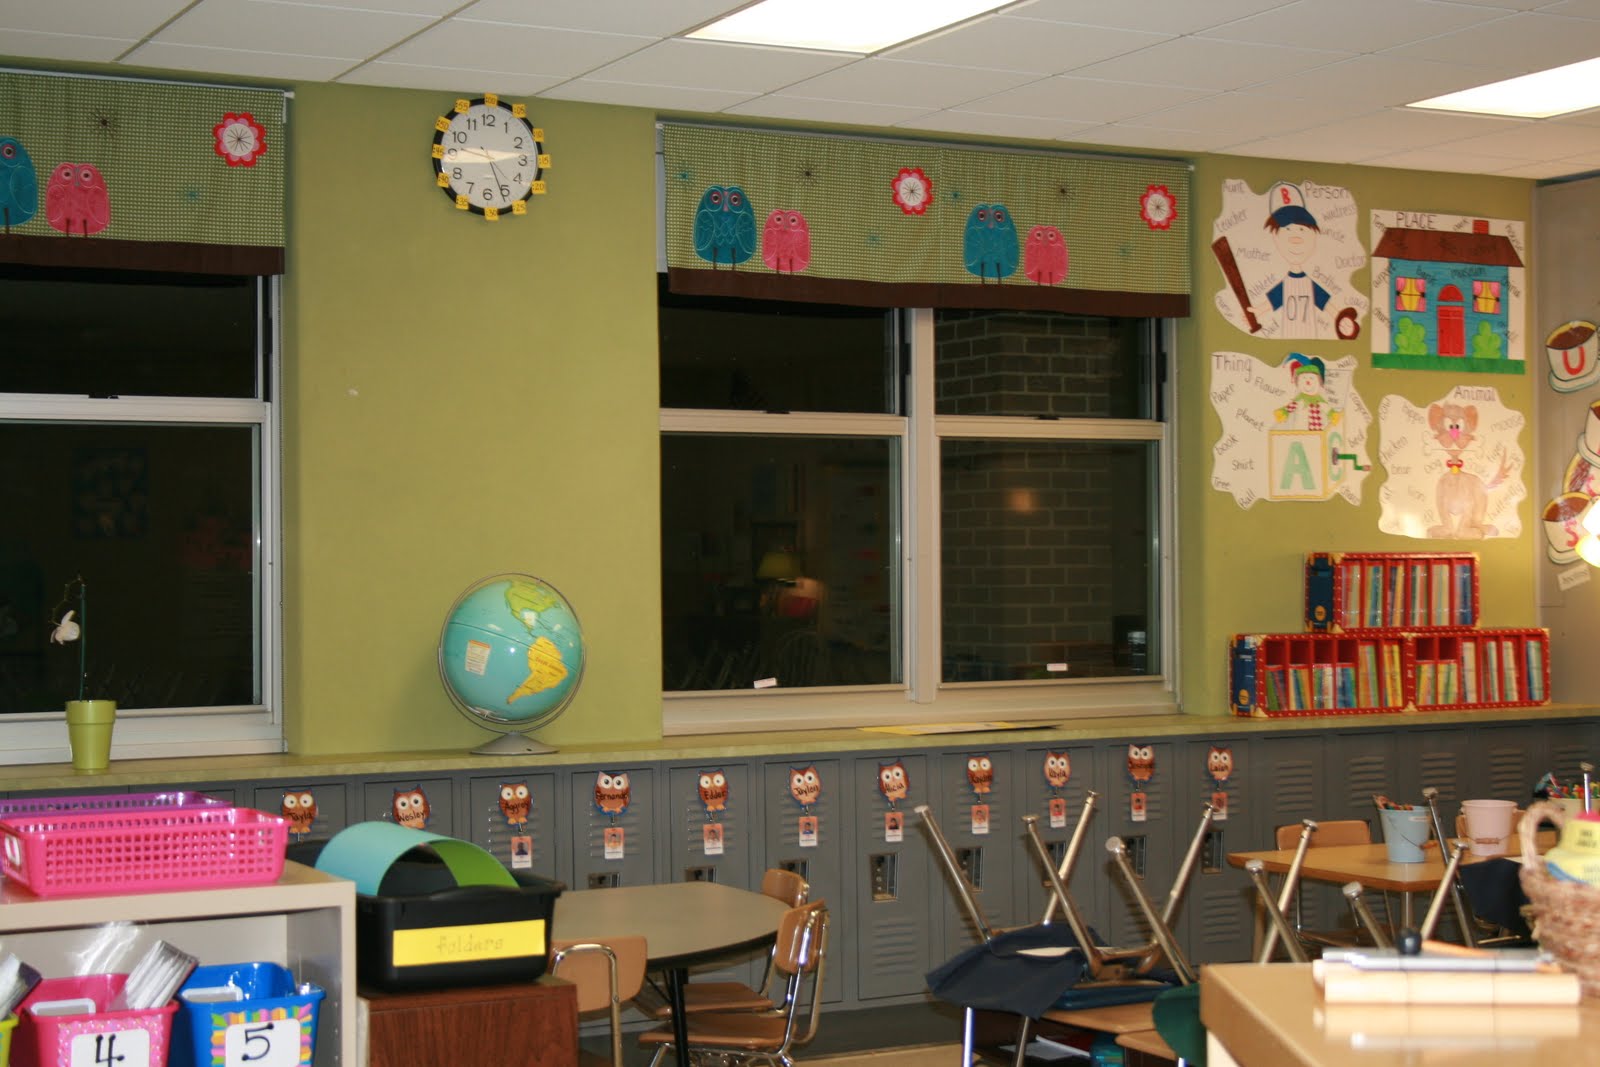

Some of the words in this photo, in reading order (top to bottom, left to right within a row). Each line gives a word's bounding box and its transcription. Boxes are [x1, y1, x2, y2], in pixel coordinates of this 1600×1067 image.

[466, 118, 478, 131] 11
[482, 114, 496, 127] 12
[504, 122, 509, 133] 1
[452, 131, 467, 144] 10
[514, 137, 523, 149] 2
[448, 148, 457, 160] 9
[518, 154, 528, 166] 3
[452, 167, 462, 180] 8
[513, 173, 522, 184] 4
[466, 181, 475, 194] 7
[483, 188, 493, 200] 6
[500, 185, 510, 197] 5
[1304, 181, 1350, 199] Person
[1280, 187, 1291, 205] B
[1396, 211, 1437, 230] PLACE
[1286, 294, 1310, 323] 07
[1562, 345, 1586, 376] U
[1211, 353, 1252, 383] Thing
[1254, 376, 1287, 397] Flower
[1453, 386, 1498, 402] Animal
[1328, 431, 1343, 481] C
[1280, 441, 1316, 490] A
[242, 1022, 274, 1061] 5
[95, 1034, 125, 1067] 4
